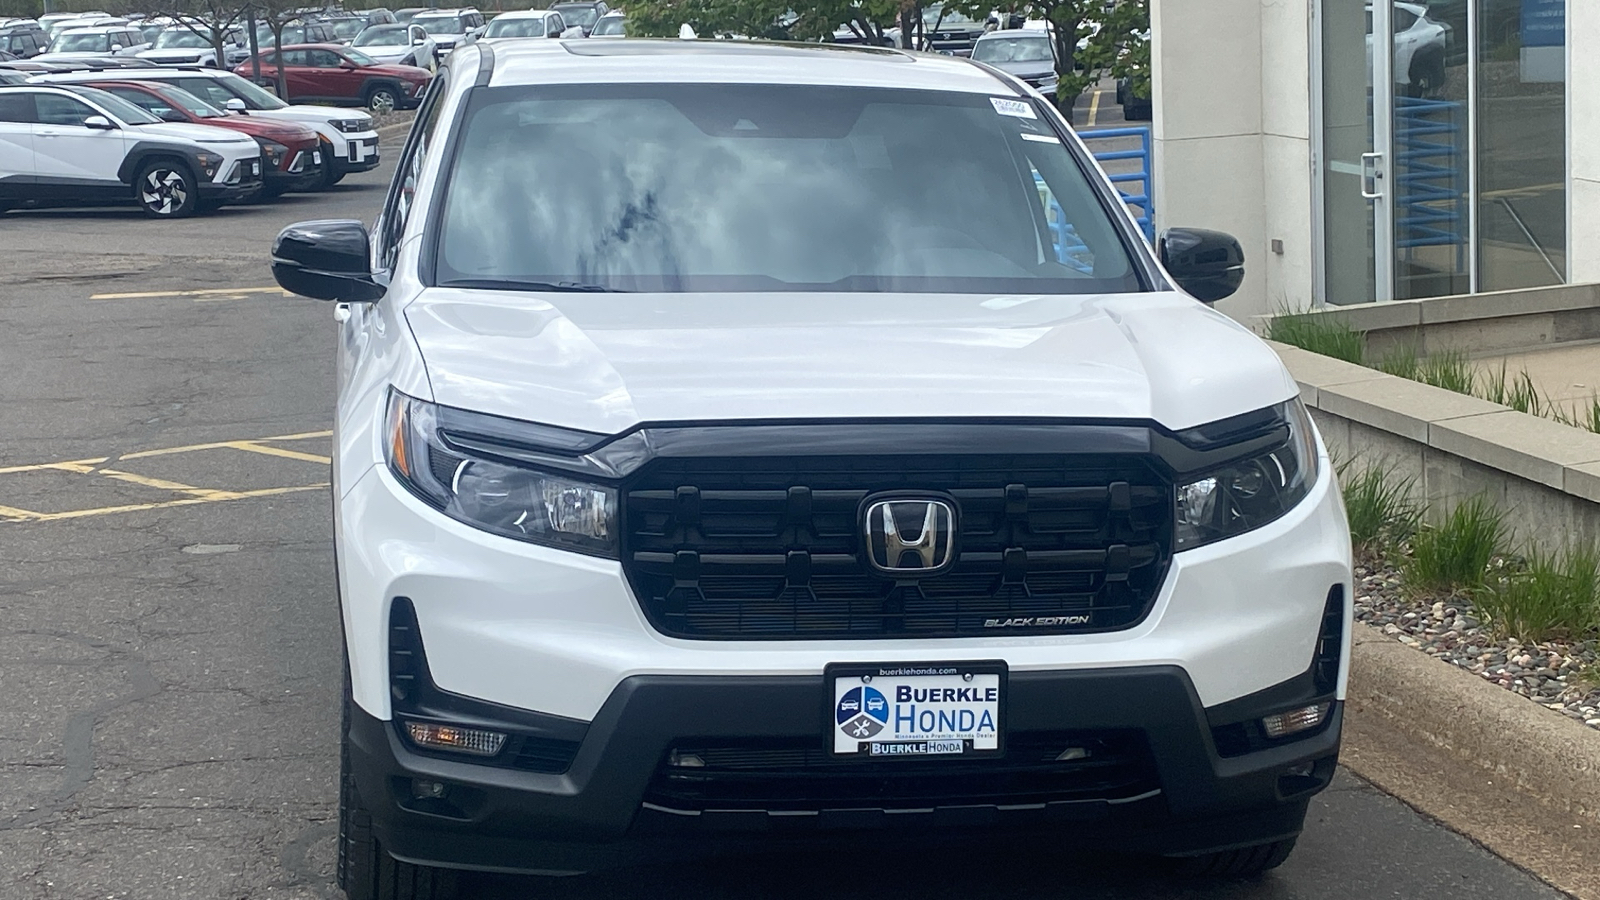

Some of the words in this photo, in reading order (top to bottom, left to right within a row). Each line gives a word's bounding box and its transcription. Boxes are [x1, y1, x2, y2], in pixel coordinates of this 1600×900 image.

[984, 618, 1033, 627] BLACK
[1035, 616, 1089, 625] EDITION
[879, 668, 957, 676] buerklehonda.com
[896, 685, 997, 703] BUERKLE
[895, 704, 995, 733] HONDA
[872, 743, 927, 754] BUERKLE
[928, 741, 961, 752] HONDA
